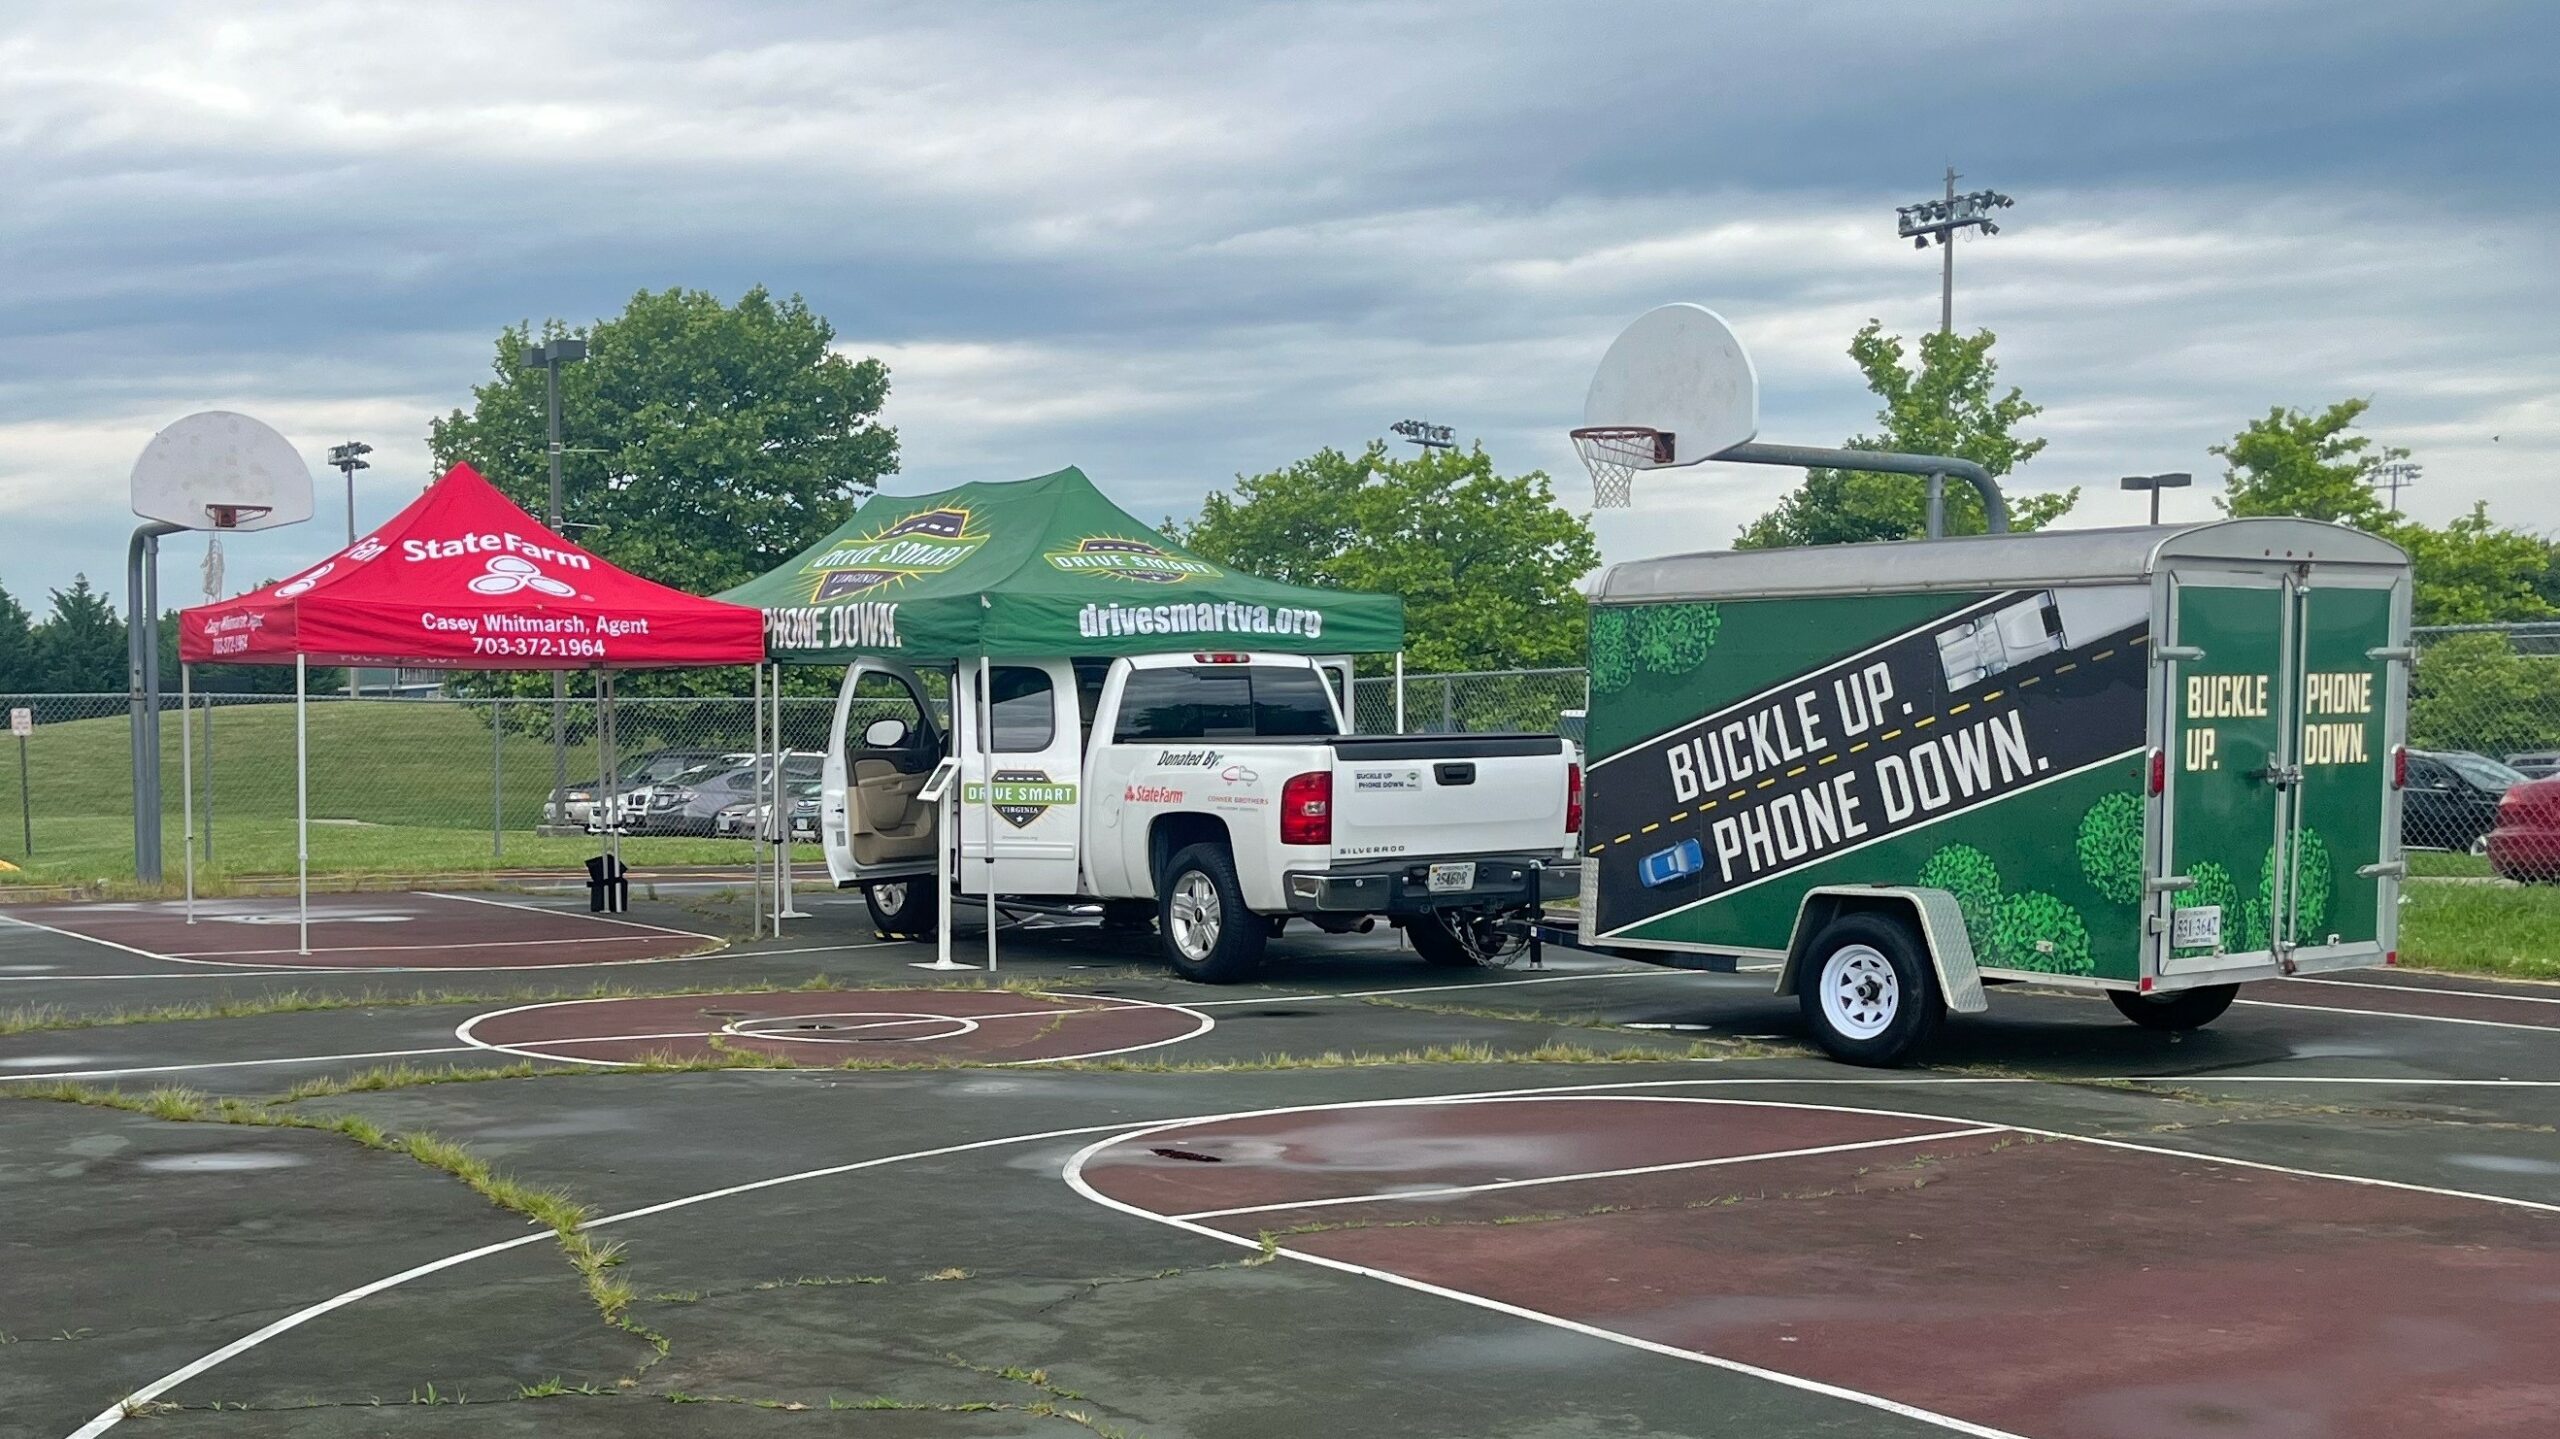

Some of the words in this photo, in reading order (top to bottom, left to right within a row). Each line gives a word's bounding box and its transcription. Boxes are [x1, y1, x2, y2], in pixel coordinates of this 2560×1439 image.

[1055, 554, 1126, 568] DRIVE
[1131, 556, 1210, 575] SMART
[421, 612, 478, 634] Casey
[482, 613, 590, 635] Whitmarsh,
[596, 615, 649, 637] Agent
[762, 606, 828, 649] PHONE
[829, 601, 903, 649] DOWN.
[1079, 601, 1323, 638] drivesmartva.org
[471, 637, 606, 657] 703-372-1964
[2187, 675, 2269, 718] BUCKLE
[2305, 673, 2373, 715] PHONE
[1667, 690, 1828, 803] BUCKLE
[1834, 661, 1914, 737] UP.
[2186, 728, 2219, 771] UP.
[2304, 723, 2369, 765] DOWN.
[1157, 750, 1204, 766] Donated
[1202, 750, 1225, 769] By:
[968, 787, 1012, 801] DRVE
[1019, 787, 1073, 801] SMART
[1001, 806, 1039, 814] VIRGINIA
[1712, 770, 1868, 883] PHONE
[1874, 709, 2050, 824] DOWN.
